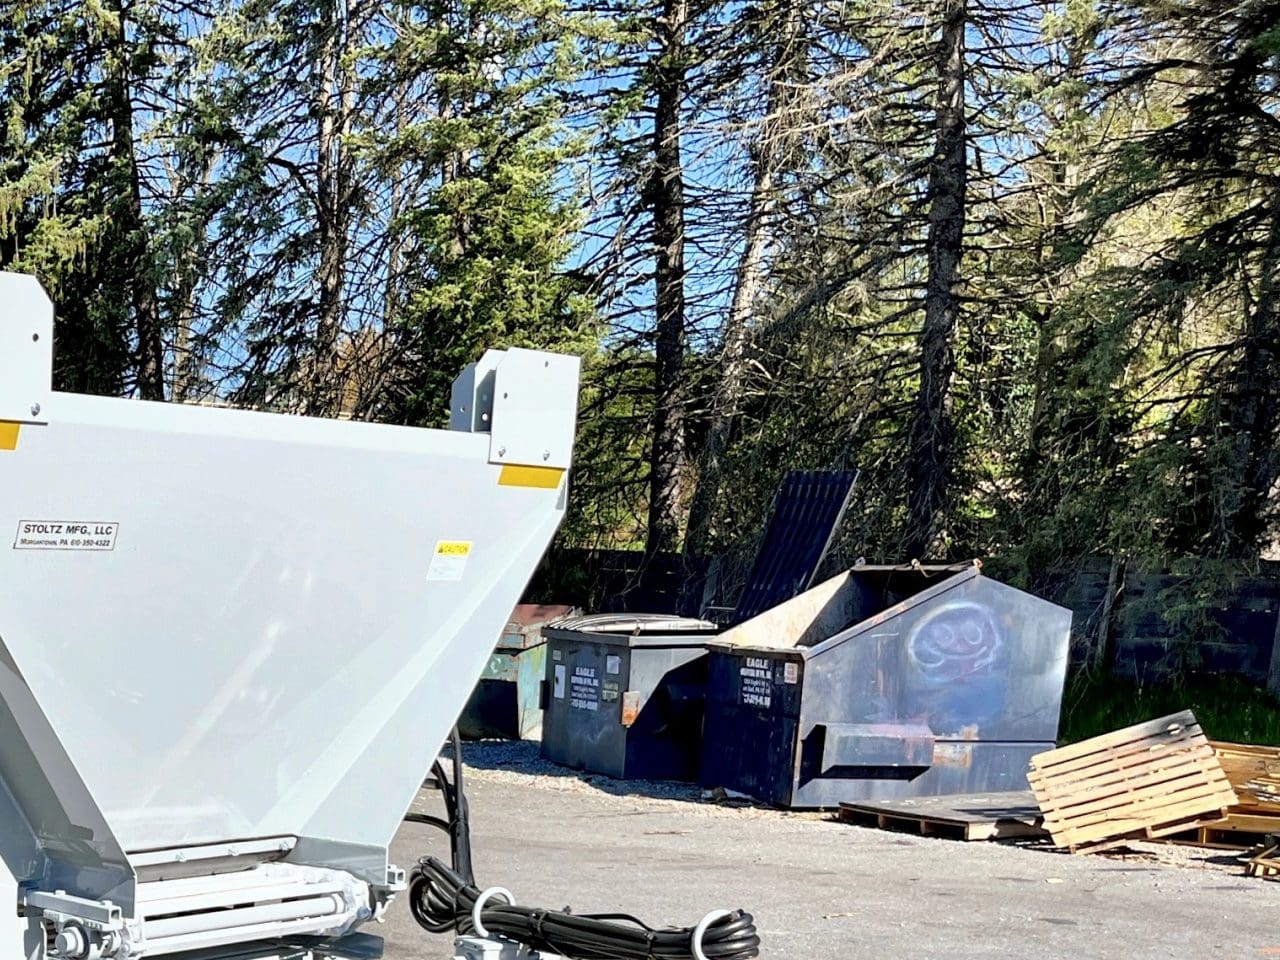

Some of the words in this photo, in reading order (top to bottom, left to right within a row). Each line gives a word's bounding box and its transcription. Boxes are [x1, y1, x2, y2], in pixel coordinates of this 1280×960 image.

[23, 524, 63, 534] STOLTZ
[94, 525, 113, 535] LLC
[746, 657, 769, 669] EAGLE
[575, 666, 595, 677] EAGLE
